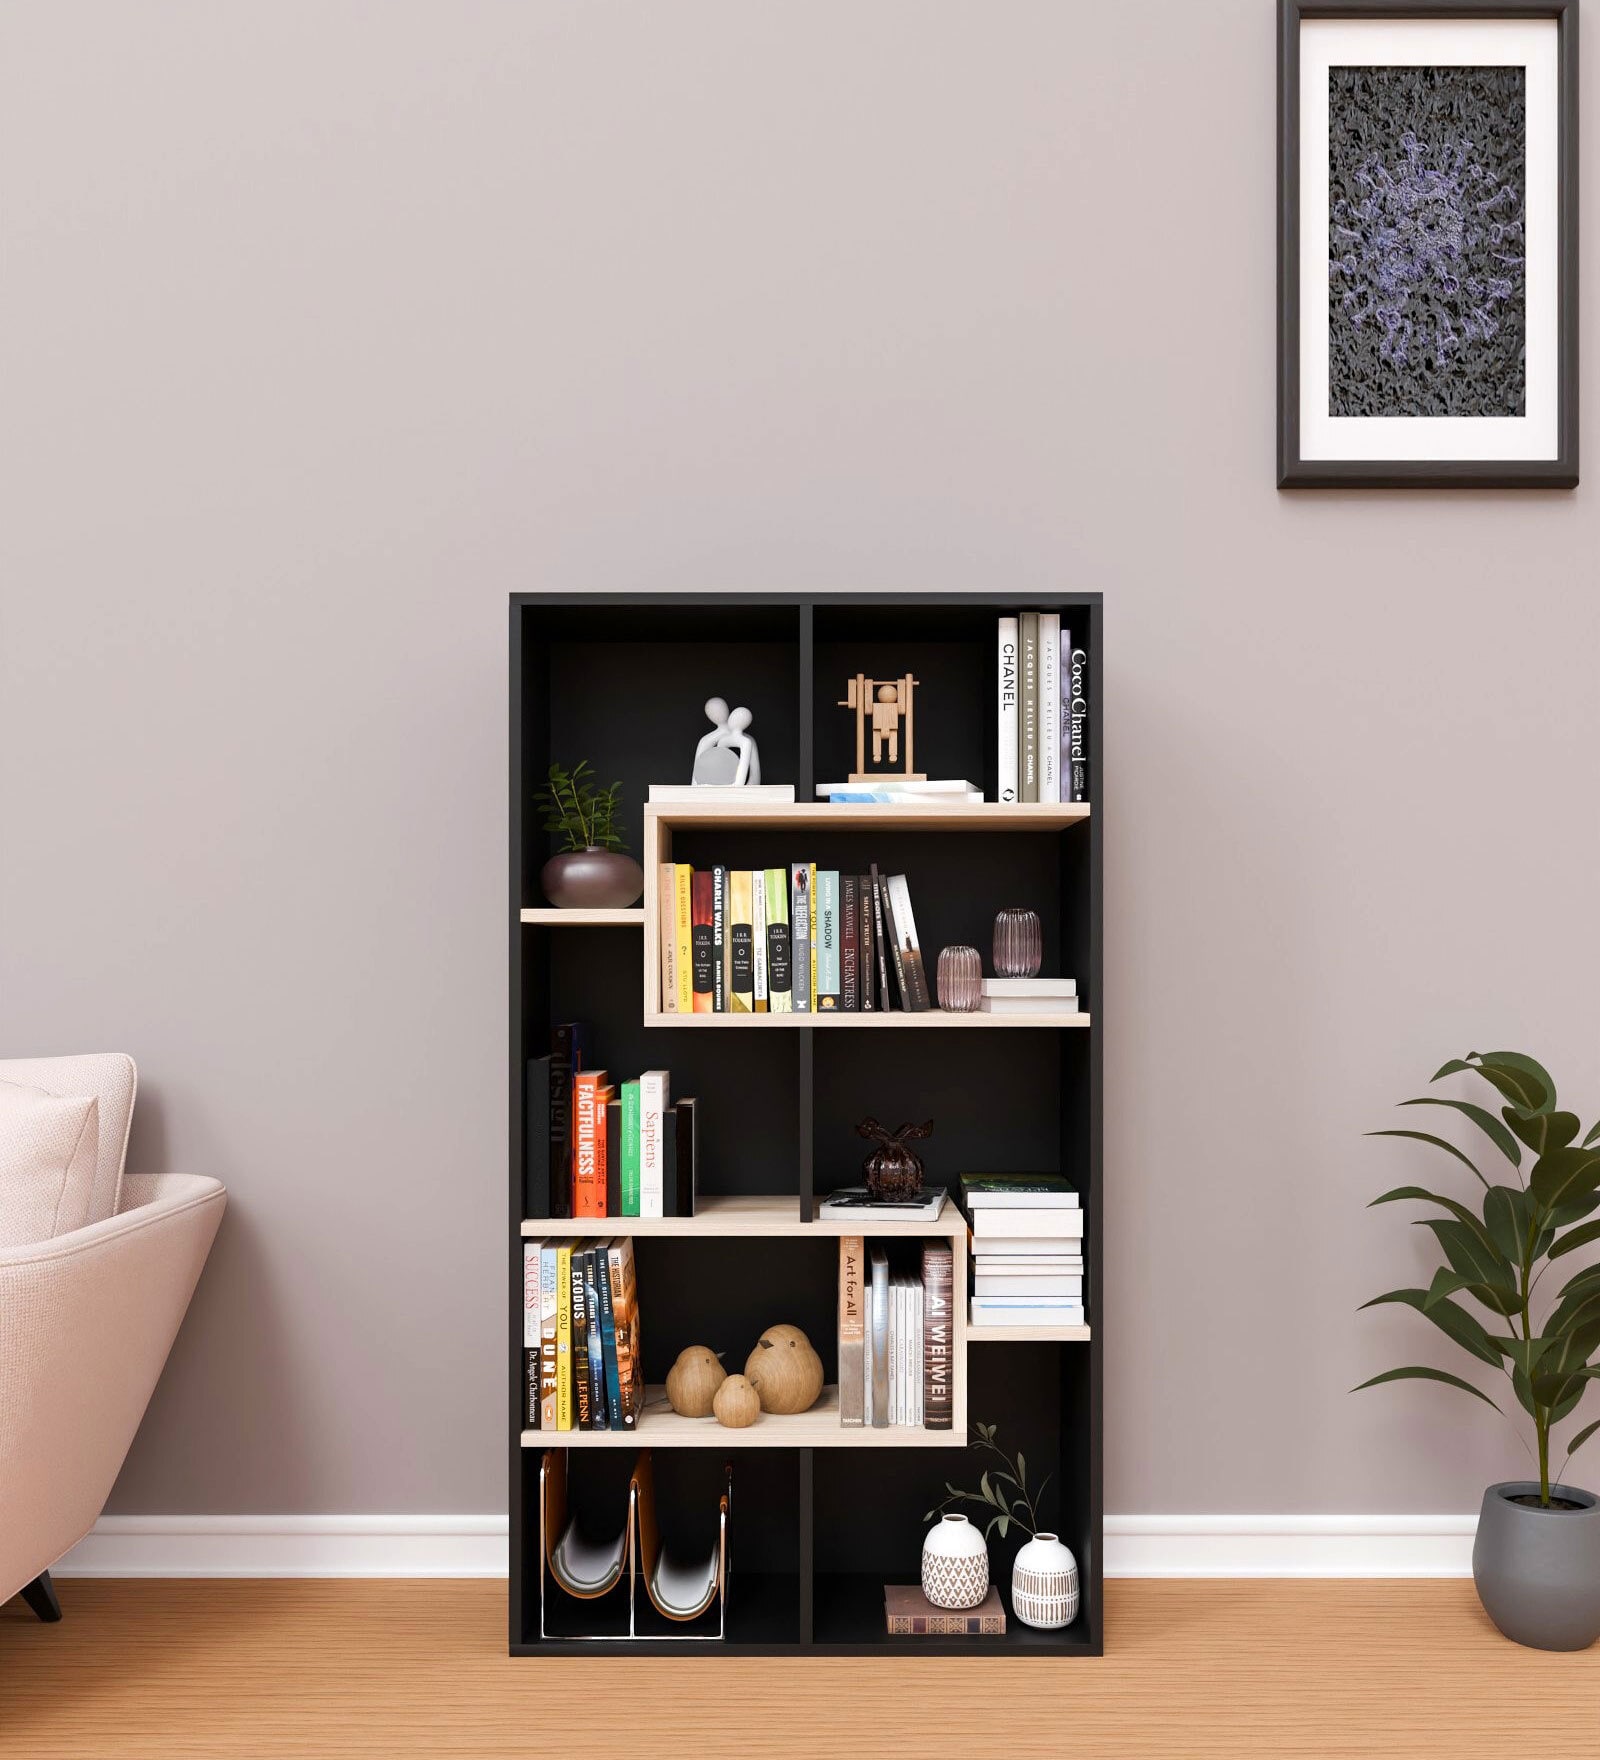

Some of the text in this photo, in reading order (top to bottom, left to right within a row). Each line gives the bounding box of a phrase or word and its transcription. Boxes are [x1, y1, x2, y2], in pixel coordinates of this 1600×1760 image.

[1003, 643, 1015, 712] CHANEL
[1026, 638, 1034, 690] JACQUES
[1046, 640, 1054, 692] JACQUES
[1026, 700, 1034, 740] HELLEU
[1046, 702, 1054, 740] HELLEU
[1062, 698, 1070, 738] CHANEL
[1070, 649, 1087, 762] Coco Chanel
[1026, 754, 1034, 785] CHANEL
[714, 868, 723, 946] CHARLIE WALKS
[797, 895, 807, 905] THE
[824, 910, 832, 950] SHADOW
[844, 880, 854, 1008] JAMES MAXWELL ENCHANTRESS
[798, 964, 806, 992] WILCKEN
[578, 1084, 594, 1176] FACTFULNESS
[642, 1111, 659, 1169] Sapiens
[525, 1256, 539, 1309] SUCCESS
[542, 1260, 550, 1310] HERBERT
[548, 1264, 556, 1300] FRANK
[600, 1271, 608, 1286] LAST
[610, 1256, 622, 1298] THE HISTORIAN
[846, 1256, 856, 1275] Art
[572, 1271, 585, 1319] EXODUS
[846, 1280, 857, 1298] for
[846, 1300, 857, 1316] All
[931, 1296, 946, 1315] AI
[560, 1305, 568, 1330] YOU
[529, 1350, 538, 1360] Dr.
[543, 1327, 556, 1388] DUNE
[931, 1324, 946, 1400] WEIWEI
[580, 1394, 589, 1422] PENN
